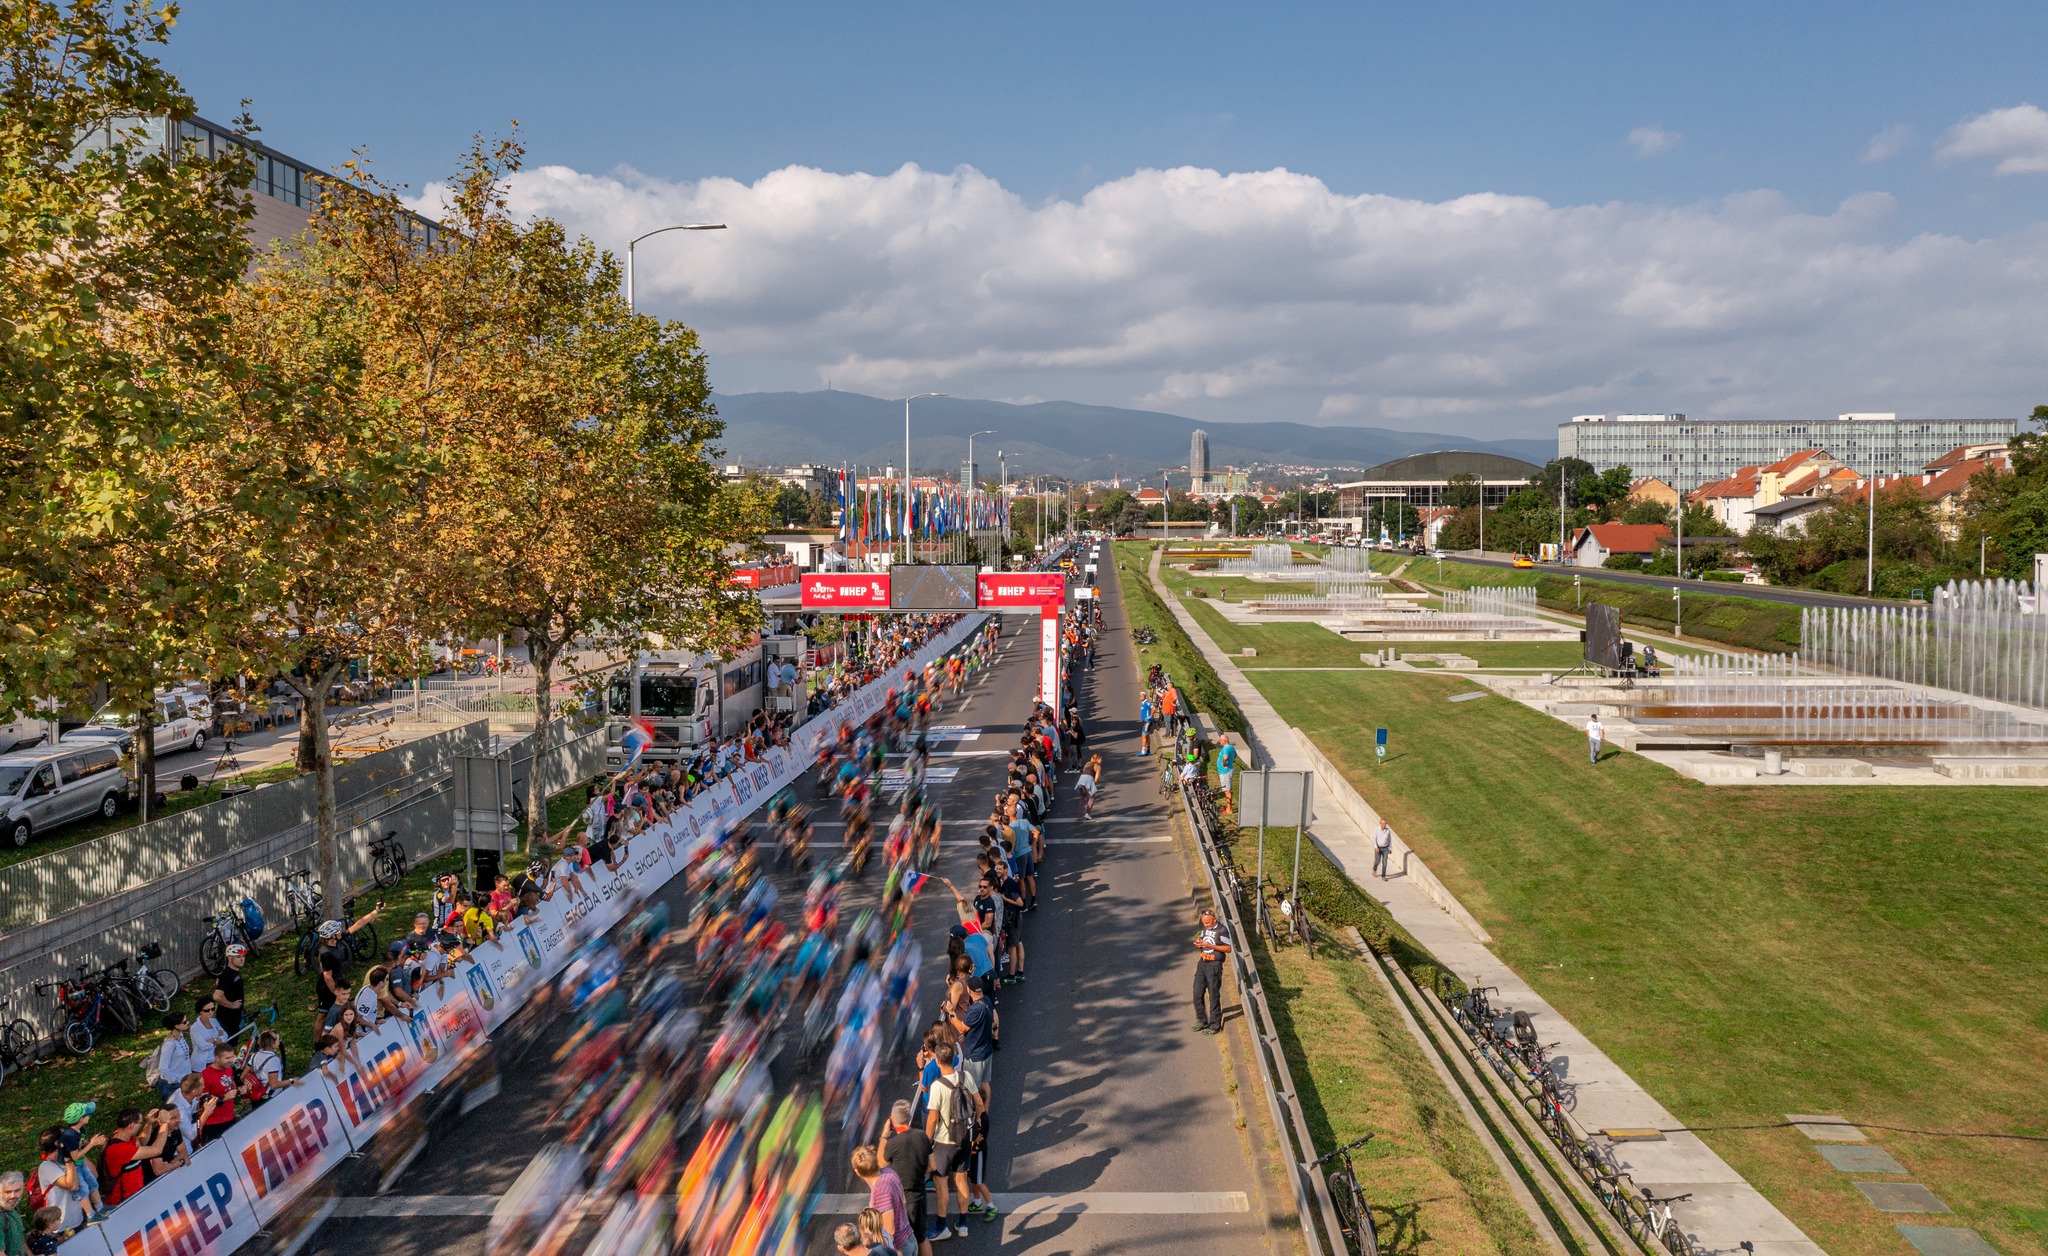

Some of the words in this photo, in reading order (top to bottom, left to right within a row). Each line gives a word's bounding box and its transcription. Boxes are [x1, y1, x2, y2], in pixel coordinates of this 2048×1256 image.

[850, 587, 867, 596] HEP
[1007, 586, 1025, 596] HEP
[673, 827, 691, 845] CARWIZ
[543, 928, 565, 952] ZAGREB
[359, 1004, 370, 1014] 28
[442, 1009, 471, 1039] ZAGREB
[270, 1098, 329, 1177] HEP
[160, 1172, 234, 1256] HEP
